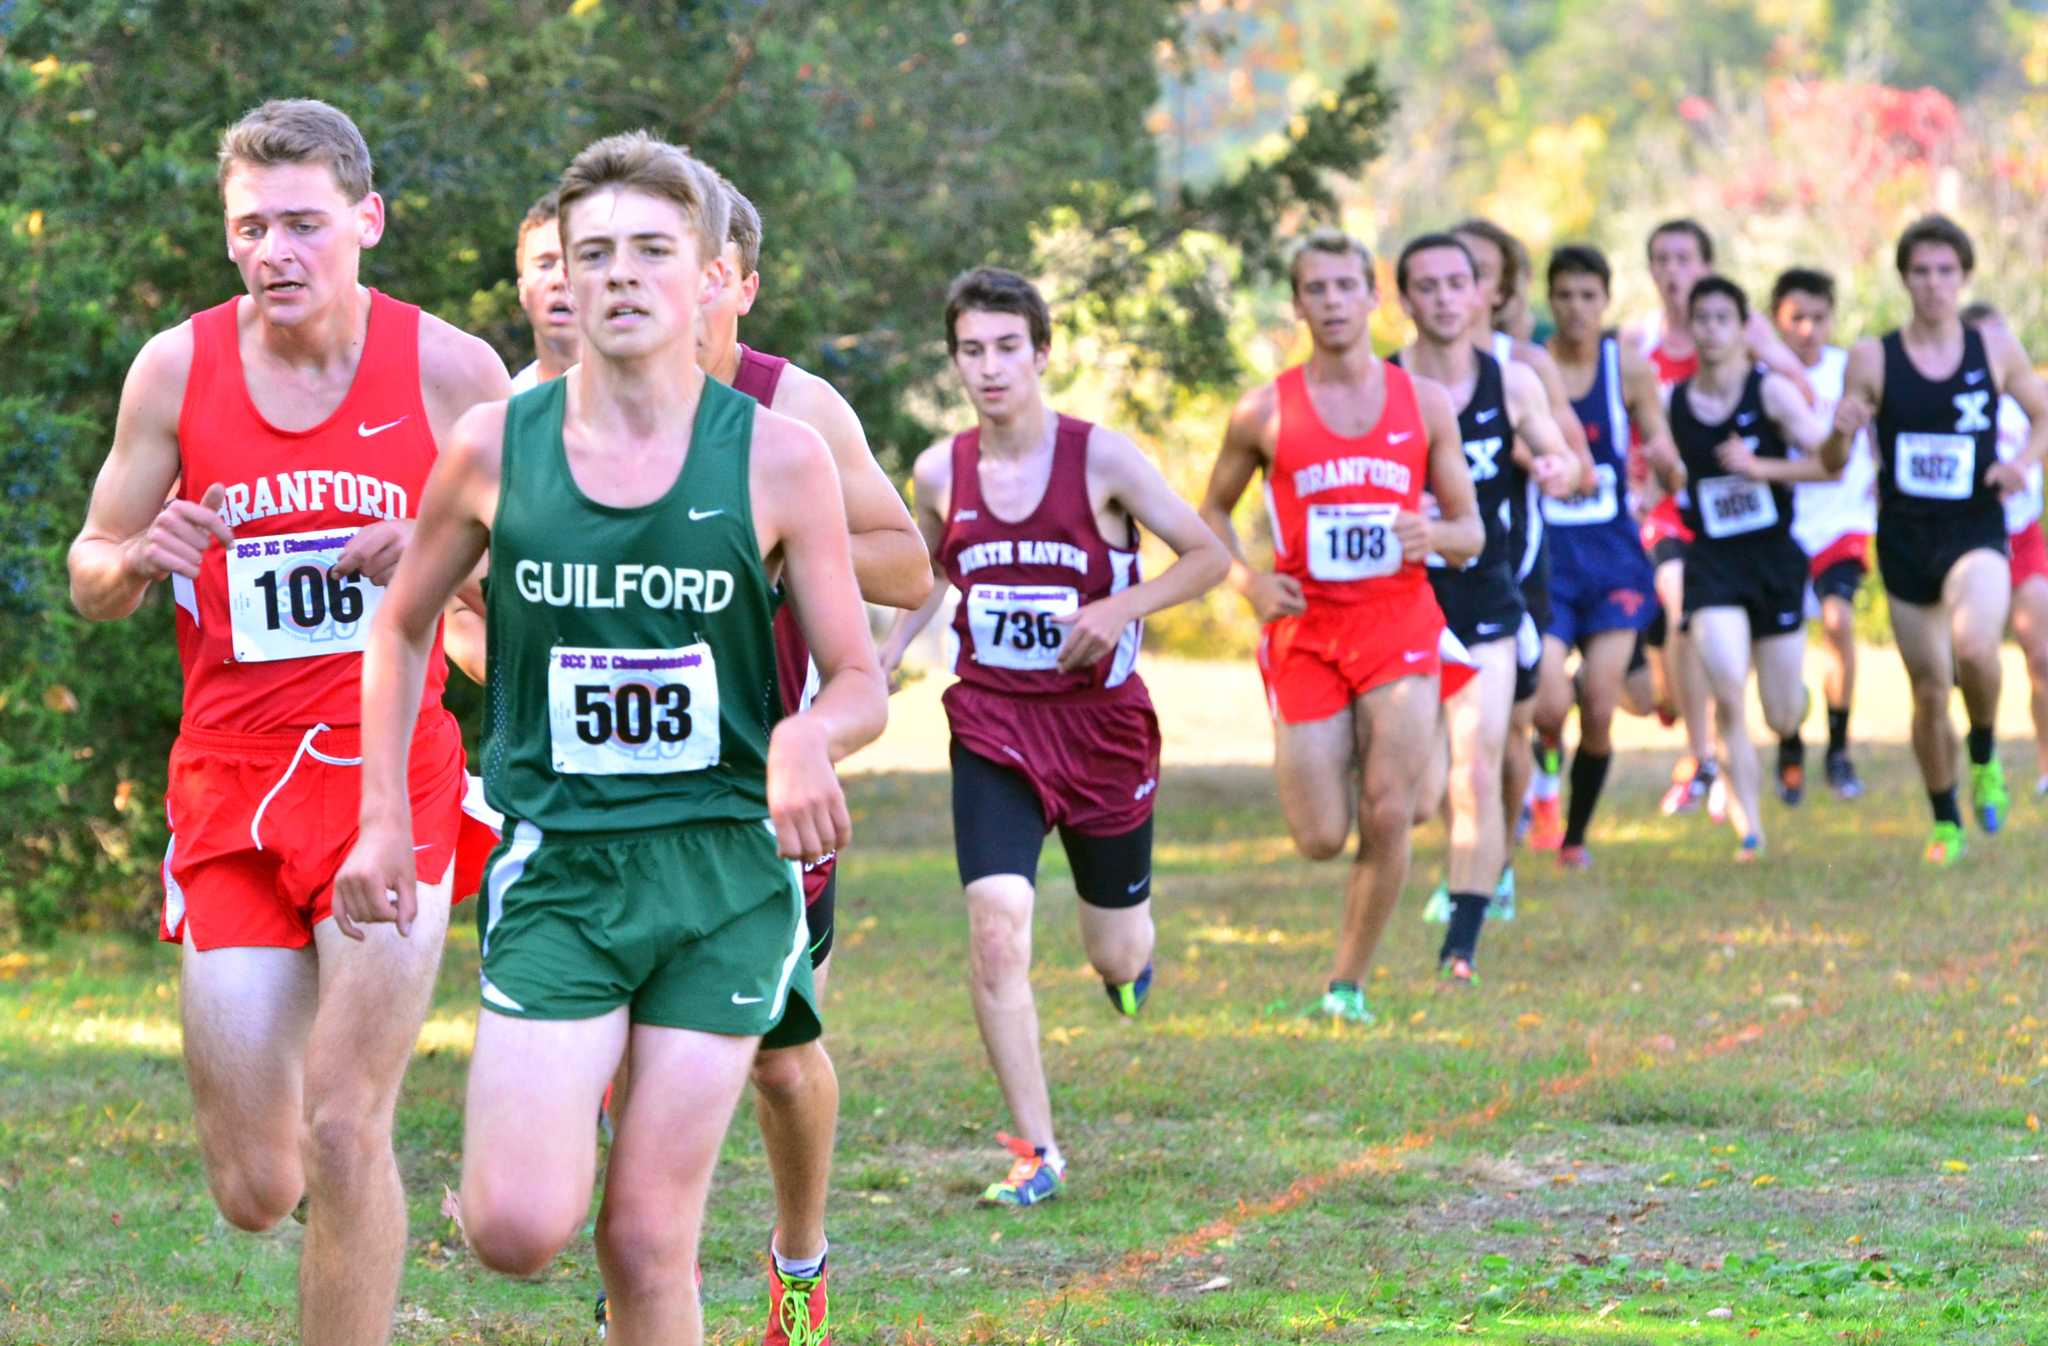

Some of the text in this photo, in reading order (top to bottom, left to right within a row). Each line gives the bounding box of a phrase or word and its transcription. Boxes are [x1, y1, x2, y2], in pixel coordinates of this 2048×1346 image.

[1953, 390, 1991, 432] X
[1294, 456, 1411, 498] BRANFORD
[1462, 436, 1502, 481] X
[237, 543, 261, 558] SCC
[264, 540, 280, 556] XC
[1018, 541, 1088, 575] HAVEN
[1326, 526, 1385, 561] 103
[254, 565, 363, 630] 106
[515, 559, 734, 613] GUILFORD
[985, 610, 1061, 650] 736
[560, 653, 702, 671] SCC XC Championship
[575, 683, 692, 745] 503
